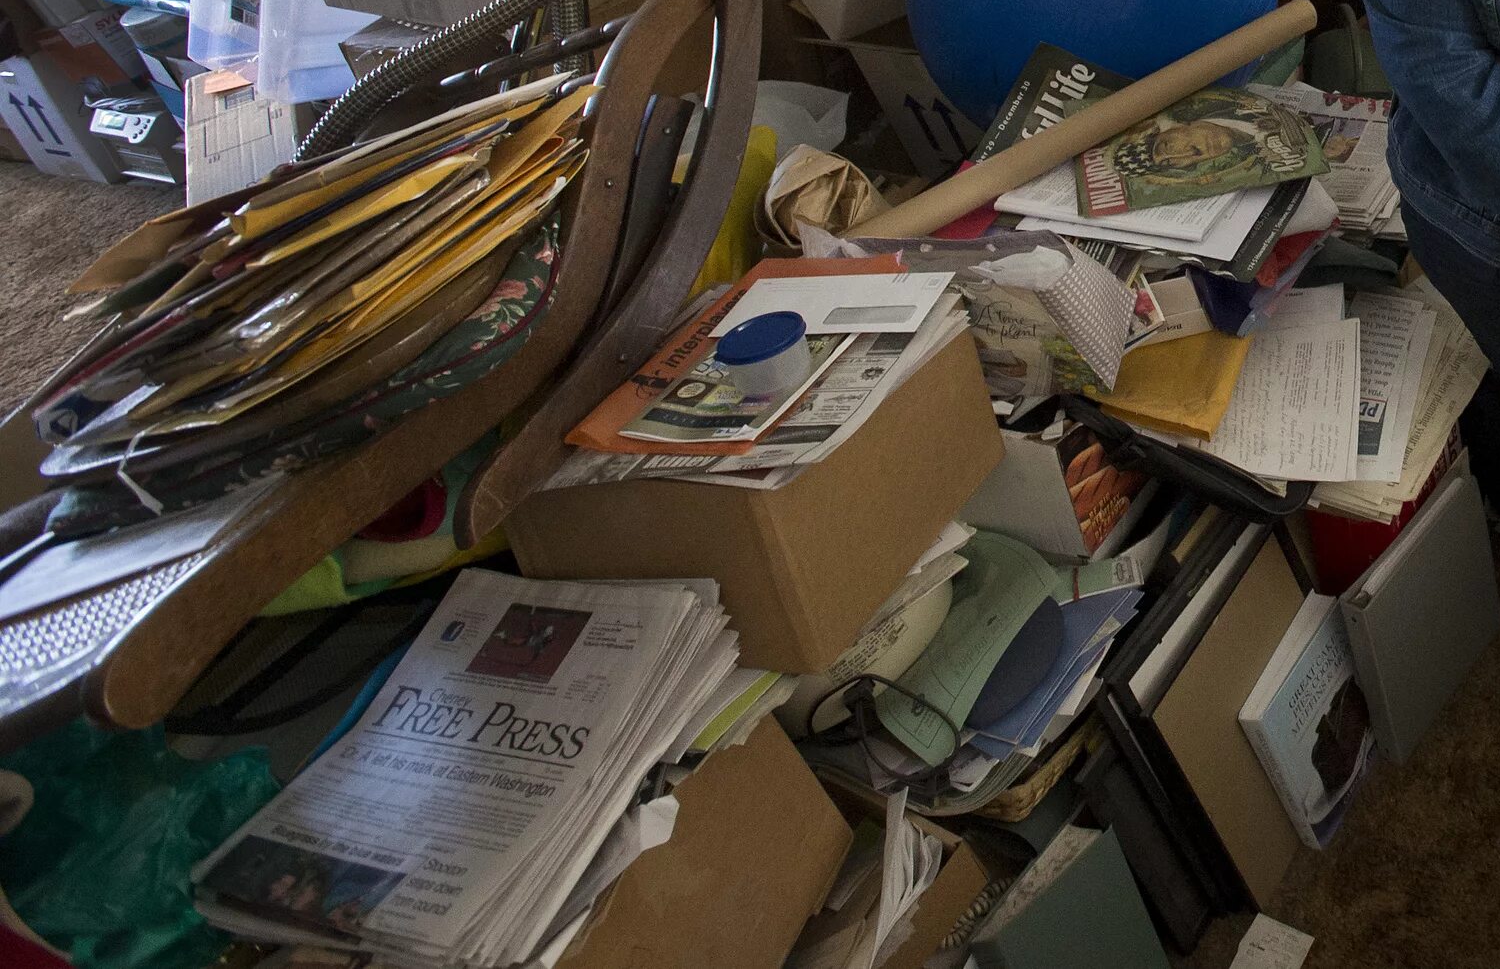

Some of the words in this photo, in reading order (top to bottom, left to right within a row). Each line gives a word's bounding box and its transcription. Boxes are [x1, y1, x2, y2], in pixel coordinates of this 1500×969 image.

[986, 141, 994, 151] 29
[999, 91, 1025, 130] December
[1021, 81, 1030, 92] 30
[1001, 324, 1035, 345] plant
[428, 687, 477, 708] Cheney
[372, 685, 473, 739] FREE
[467, 701, 591, 760] PRESS
[391, 755, 407, 769] his
[408, 760, 433, 774] mark
[446, 765, 490, 786] Eastern
[490, 770, 556, 798] Washington
